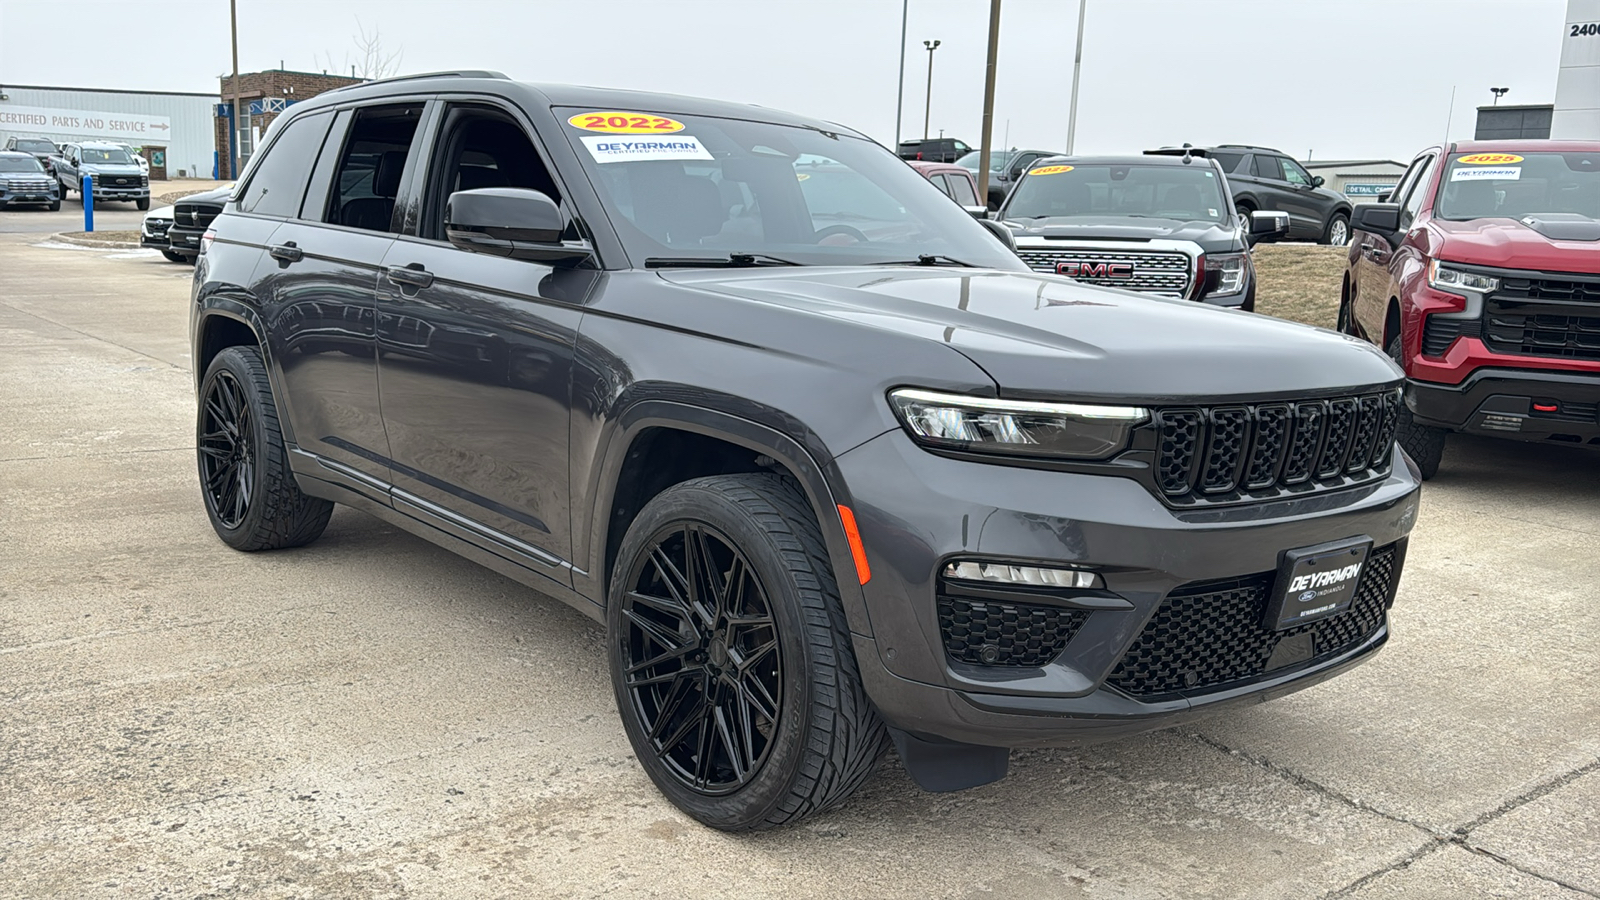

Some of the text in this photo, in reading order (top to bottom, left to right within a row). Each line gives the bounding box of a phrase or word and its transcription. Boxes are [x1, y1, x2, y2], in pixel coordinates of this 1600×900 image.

[0, 112, 146, 132] CERTIFIED PARTS AND SERVICE
[584, 116, 674, 130] 2022
[597, 142, 697, 151] DEYARMAN
[1057, 263, 1132, 277] GMC
[1288, 562, 1362, 592] DEYARMAN
[1317, 585, 1345, 596] INDIANOLA
